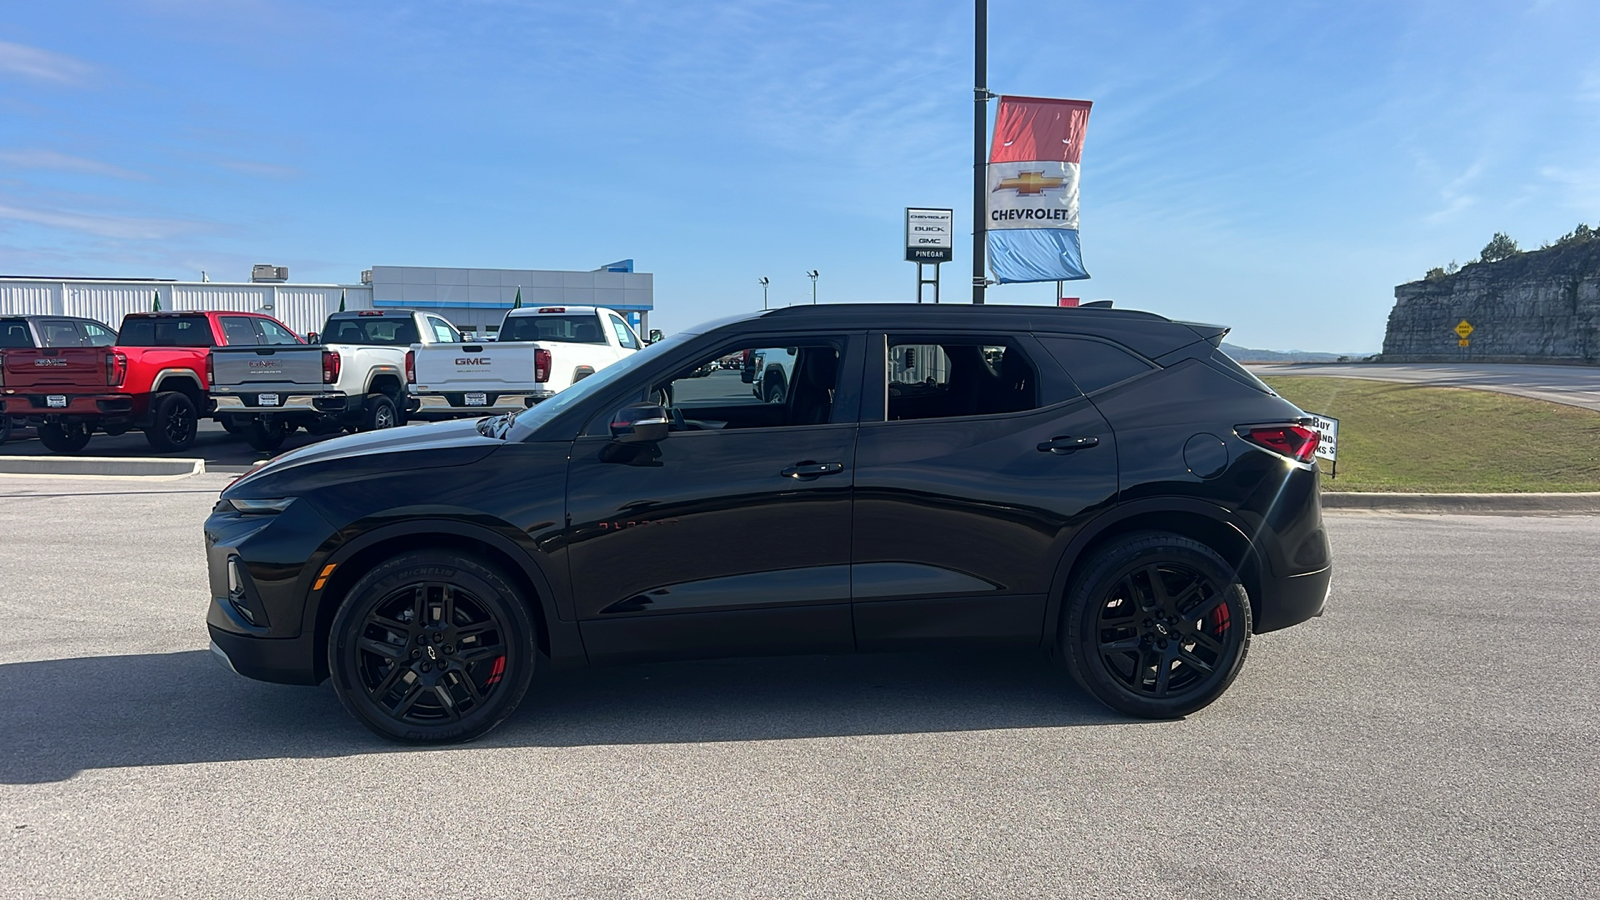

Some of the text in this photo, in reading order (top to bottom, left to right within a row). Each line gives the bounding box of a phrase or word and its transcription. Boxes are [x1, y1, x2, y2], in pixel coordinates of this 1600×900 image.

[991, 208, 1068, 221] CHEVROLET
[915, 250, 944, 258] PINEGAR
[34, 358, 67, 367] GMC
[248, 358, 283, 368] GMC
[455, 357, 491, 366] GMC
[398, 567, 455, 580] MICHELIN
